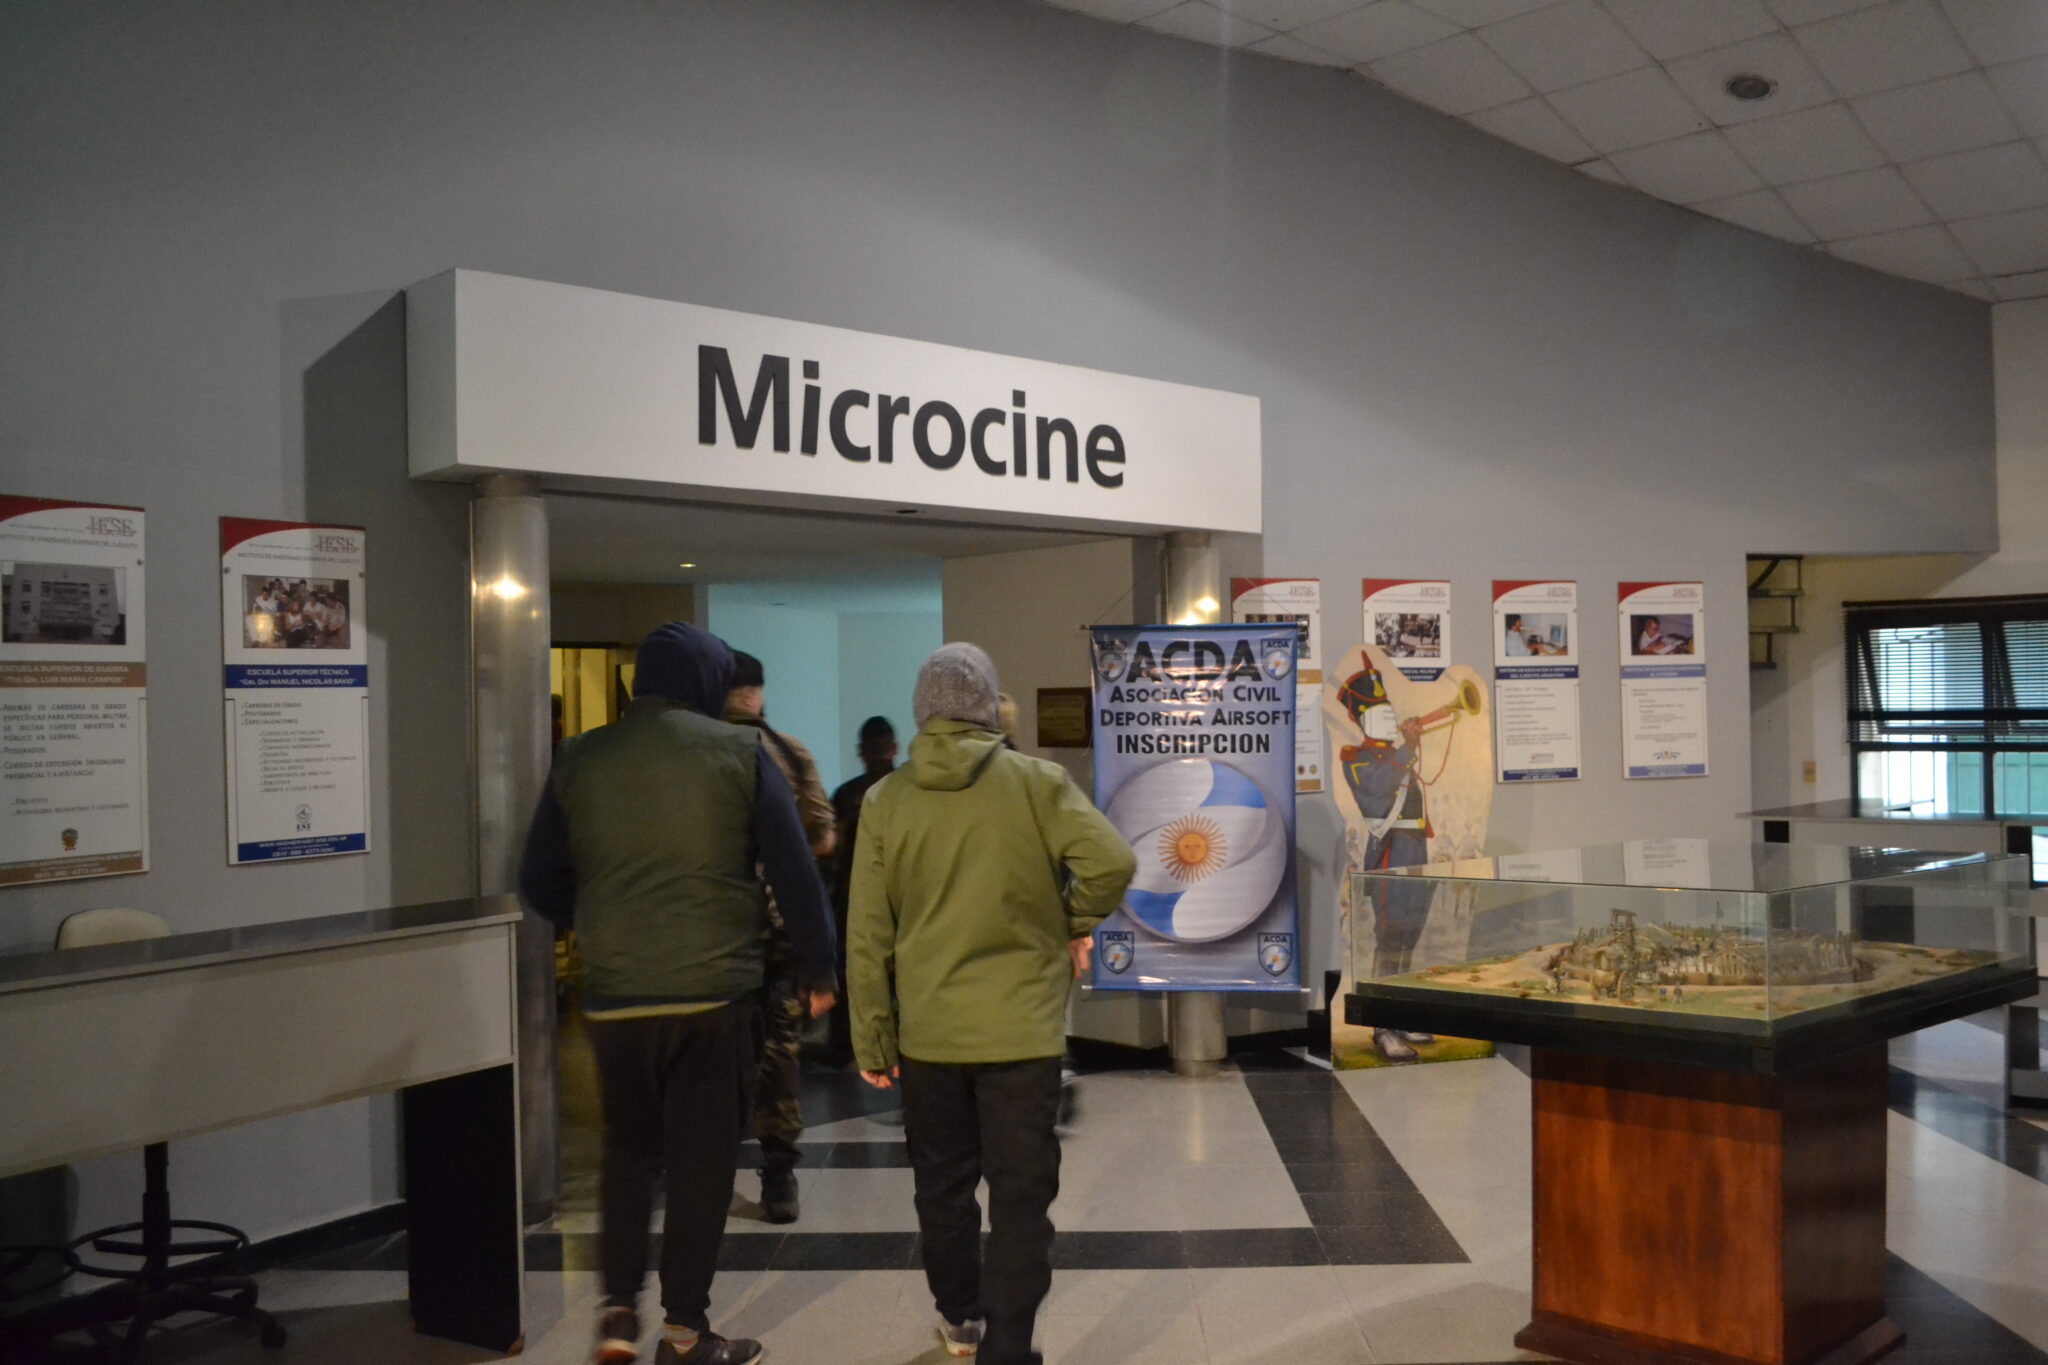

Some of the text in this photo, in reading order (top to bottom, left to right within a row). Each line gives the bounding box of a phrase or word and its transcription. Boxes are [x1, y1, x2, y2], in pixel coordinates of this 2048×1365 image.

[698, 344, 1126, 488] Microcine
[1126, 639, 1263, 683] ACDA
[1110, 685, 1281, 703] ASOCIACION CIVIL
[1101, 709, 1202, 726] DEPORTIVA
[1211, 708, 1290, 726] AIRSOFT
[1117, 734, 1270, 754] INSCRIPCION
[1106, 934, 1129, 942] ACDA
[1263, 936, 1287, 944] ACDA
